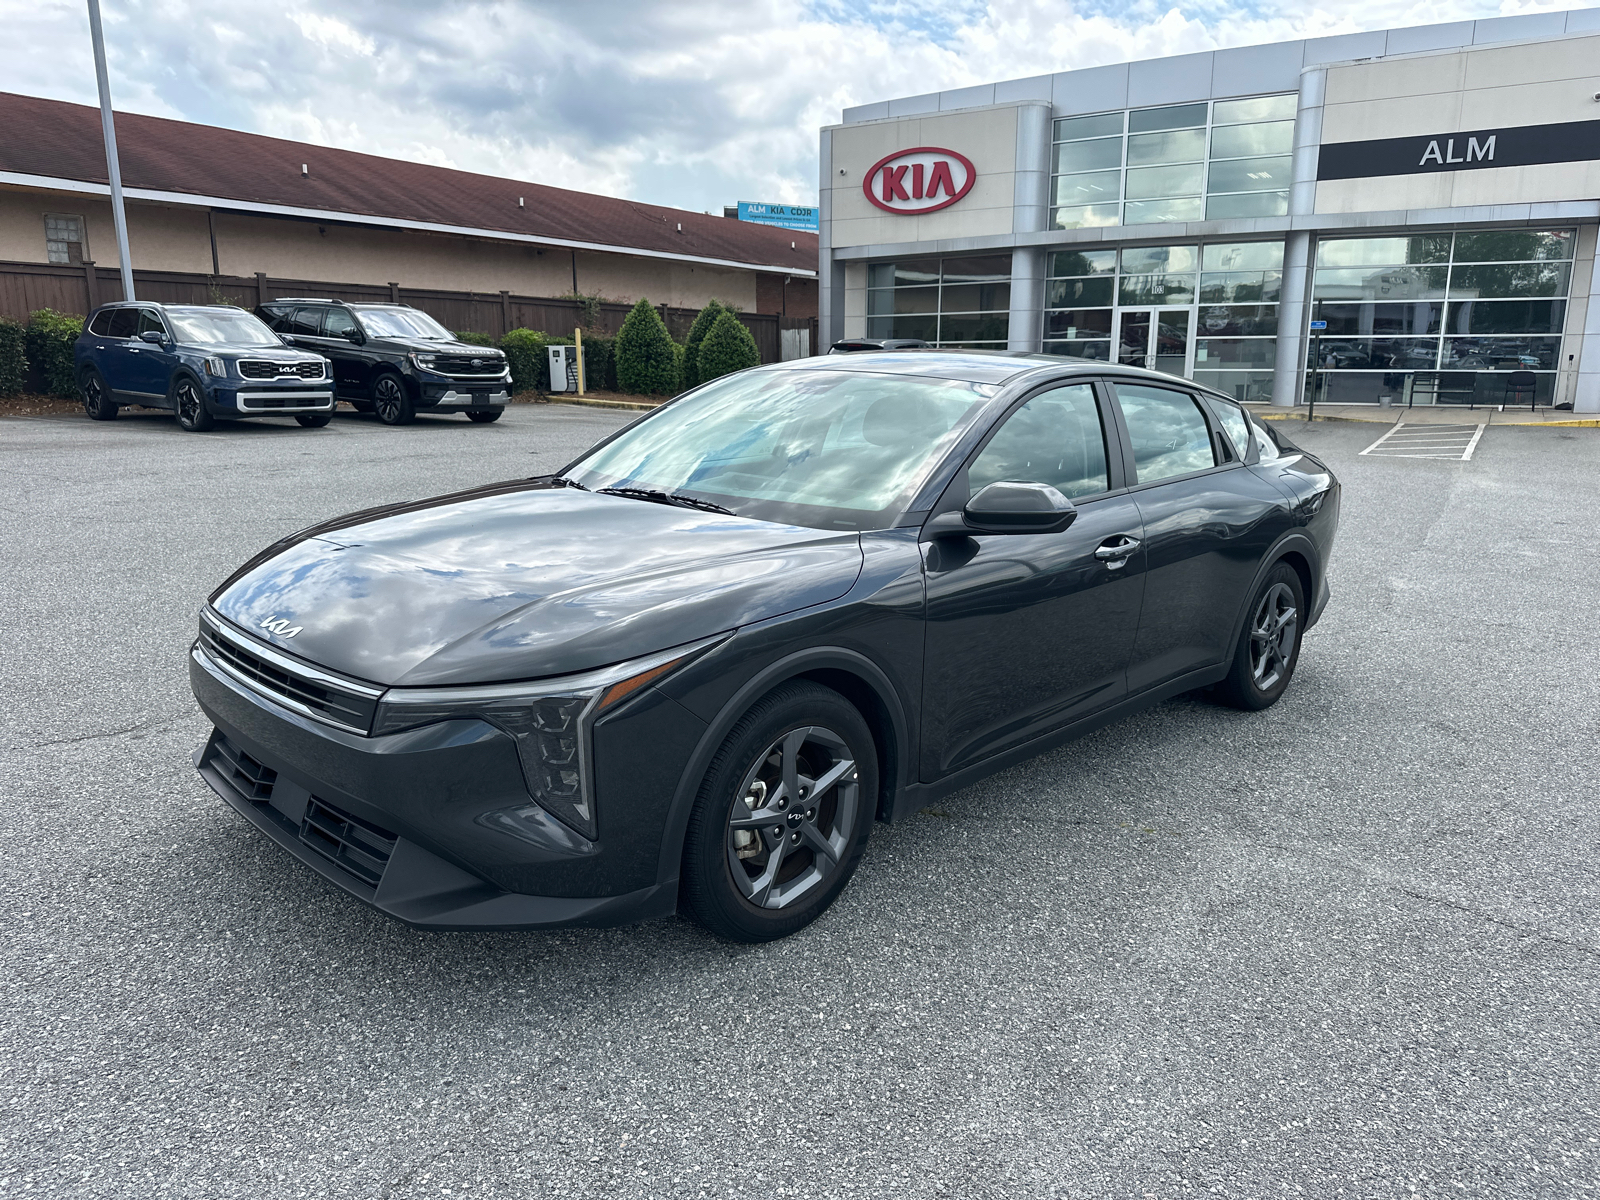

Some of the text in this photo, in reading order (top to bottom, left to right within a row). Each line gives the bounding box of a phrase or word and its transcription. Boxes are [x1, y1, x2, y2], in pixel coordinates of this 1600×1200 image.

[1419, 135, 1497, 166] ALM
[882, 161, 956, 202] KIA
[748, 205, 812, 217] ALM KIA CDJR
[260, 615, 304, 640] KIA
